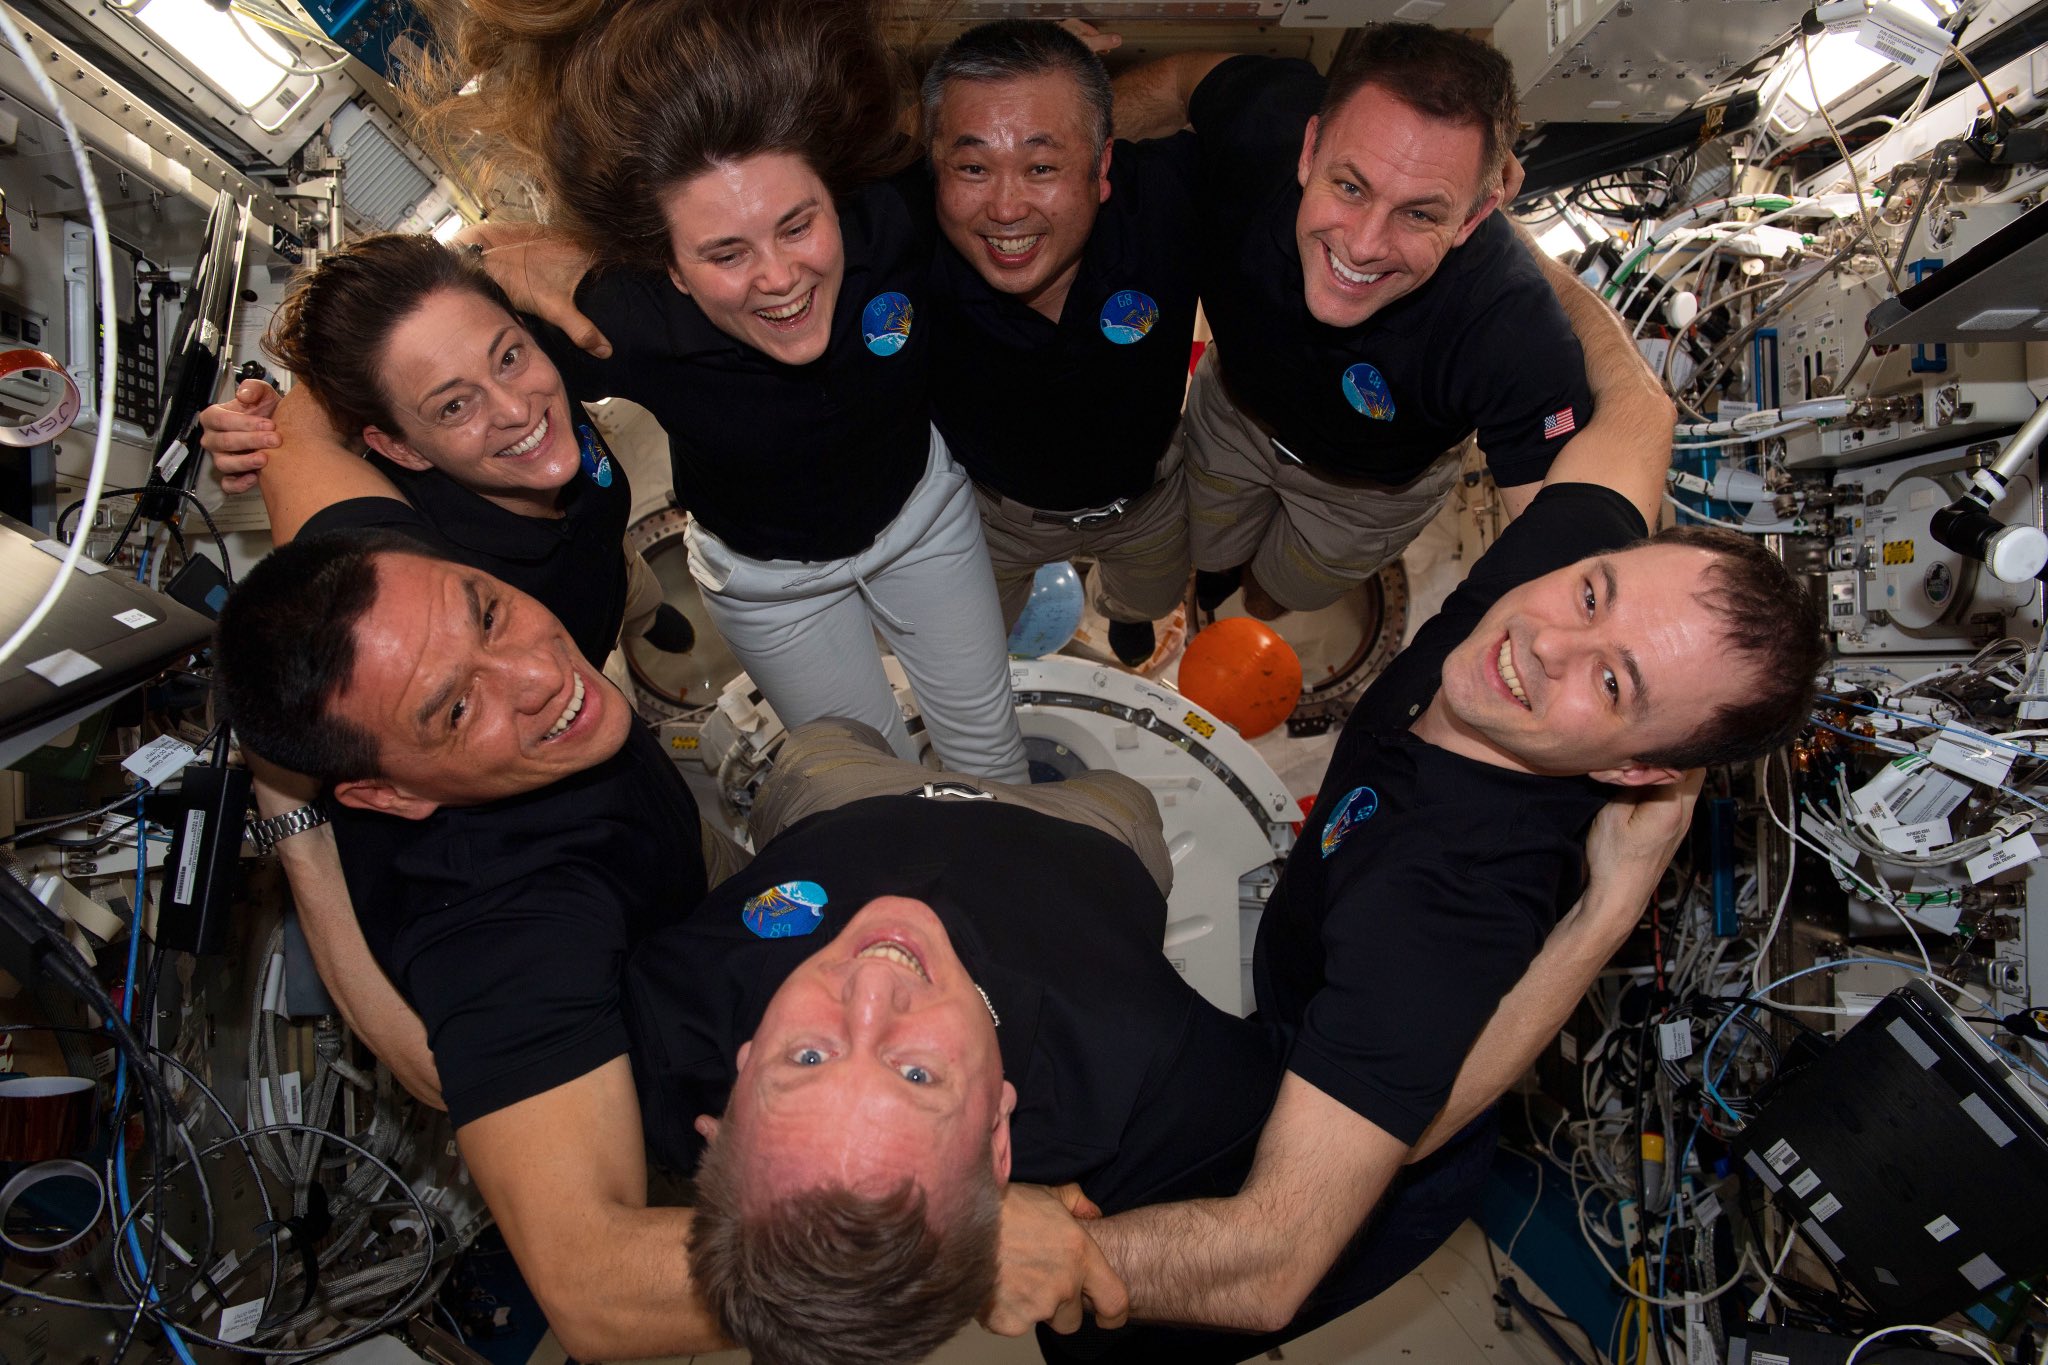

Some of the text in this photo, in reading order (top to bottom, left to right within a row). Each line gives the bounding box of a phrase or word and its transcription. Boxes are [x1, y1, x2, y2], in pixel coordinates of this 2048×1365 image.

[1869, 154, 1878, 173] 4
[1941, 240, 1954, 251] CLOSE
[871, 297, 887, 317] 68
[1117, 293, 1133, 308] 68
[1369, 370, 1381, 389] 68
[18, 401, 70, 437] JGM
[2002, 853, 2016, 863] DEBUG
[770, 923, 791, 938] 68
